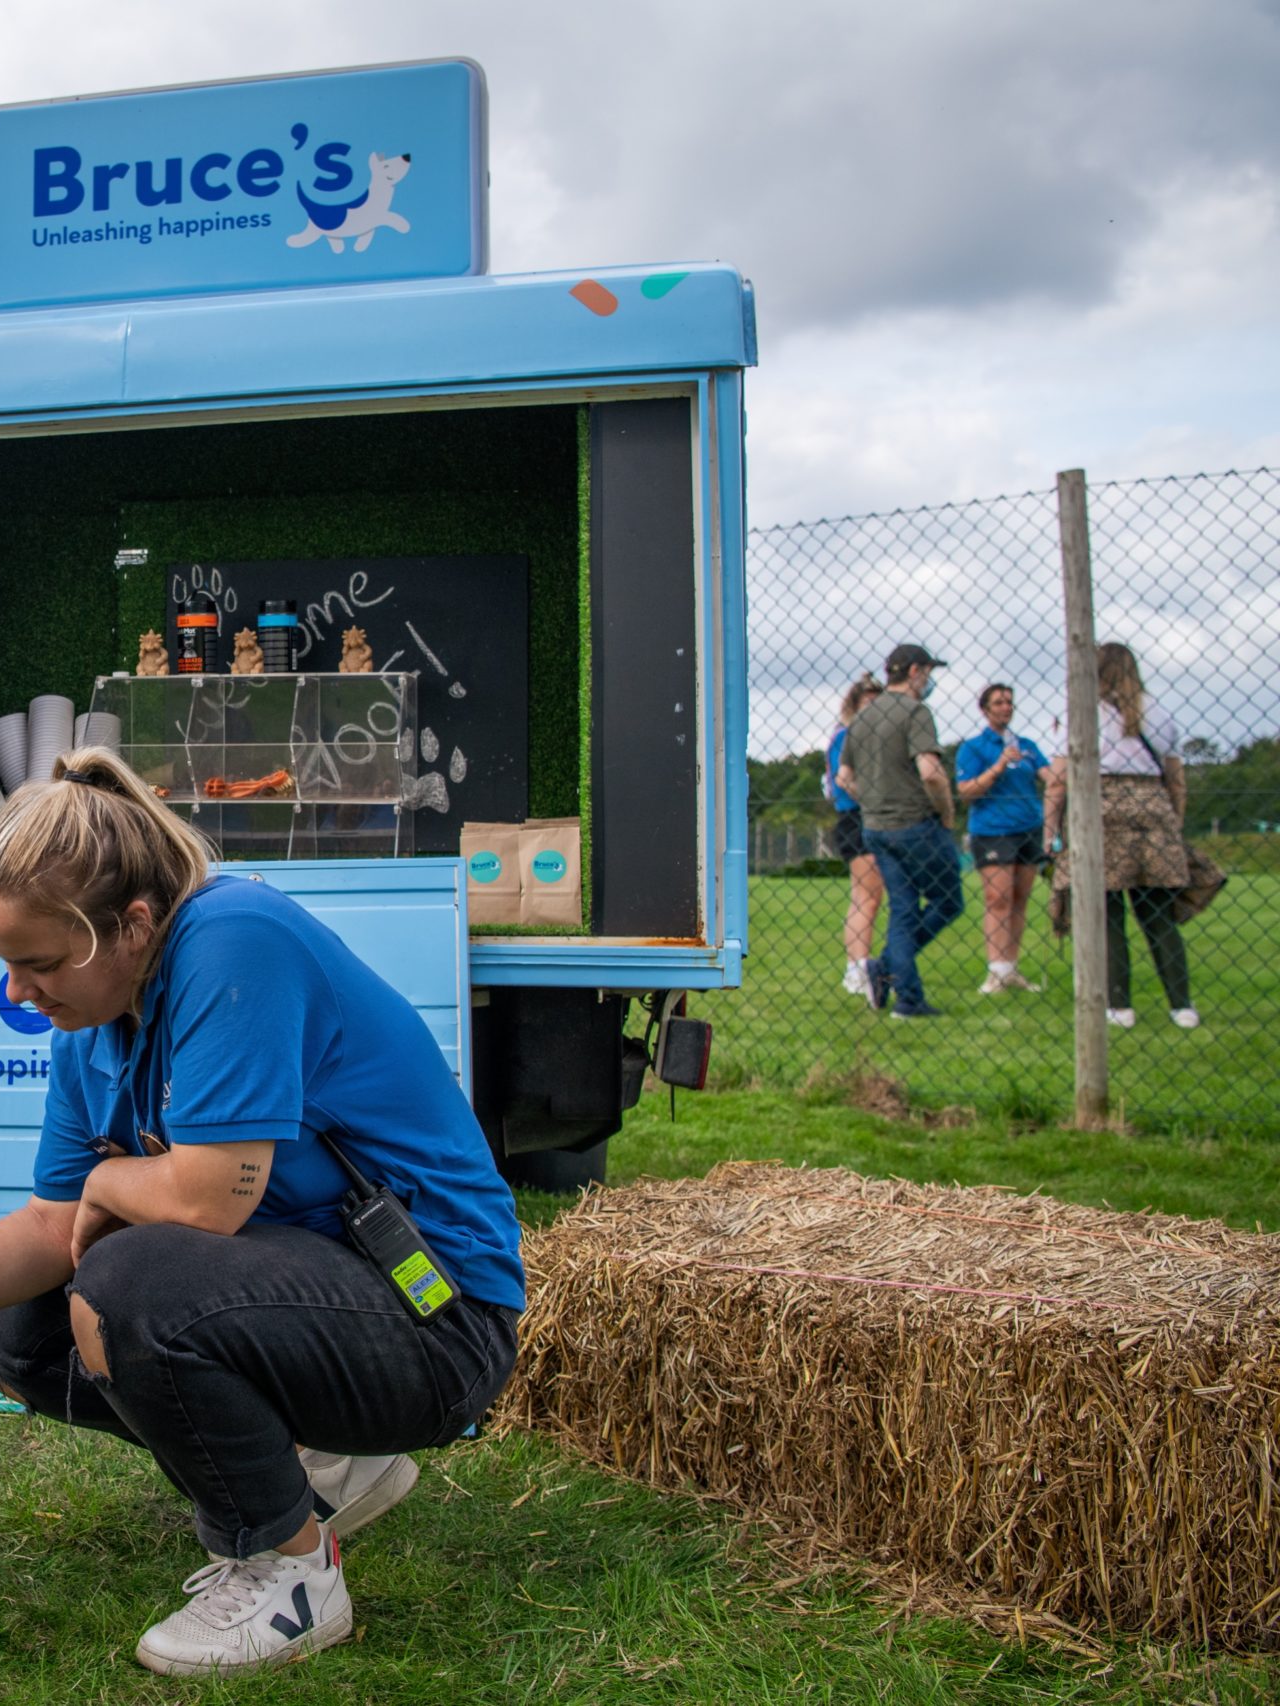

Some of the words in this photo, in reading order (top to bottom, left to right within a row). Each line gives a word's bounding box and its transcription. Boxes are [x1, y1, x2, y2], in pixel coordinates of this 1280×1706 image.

[32, 122, 355, 218] Bruce's
[31, 219, 152, 248] Unleashing
[157, 211, 273, 239] happiness
[412, 1276, 430, 1293] ALEX
